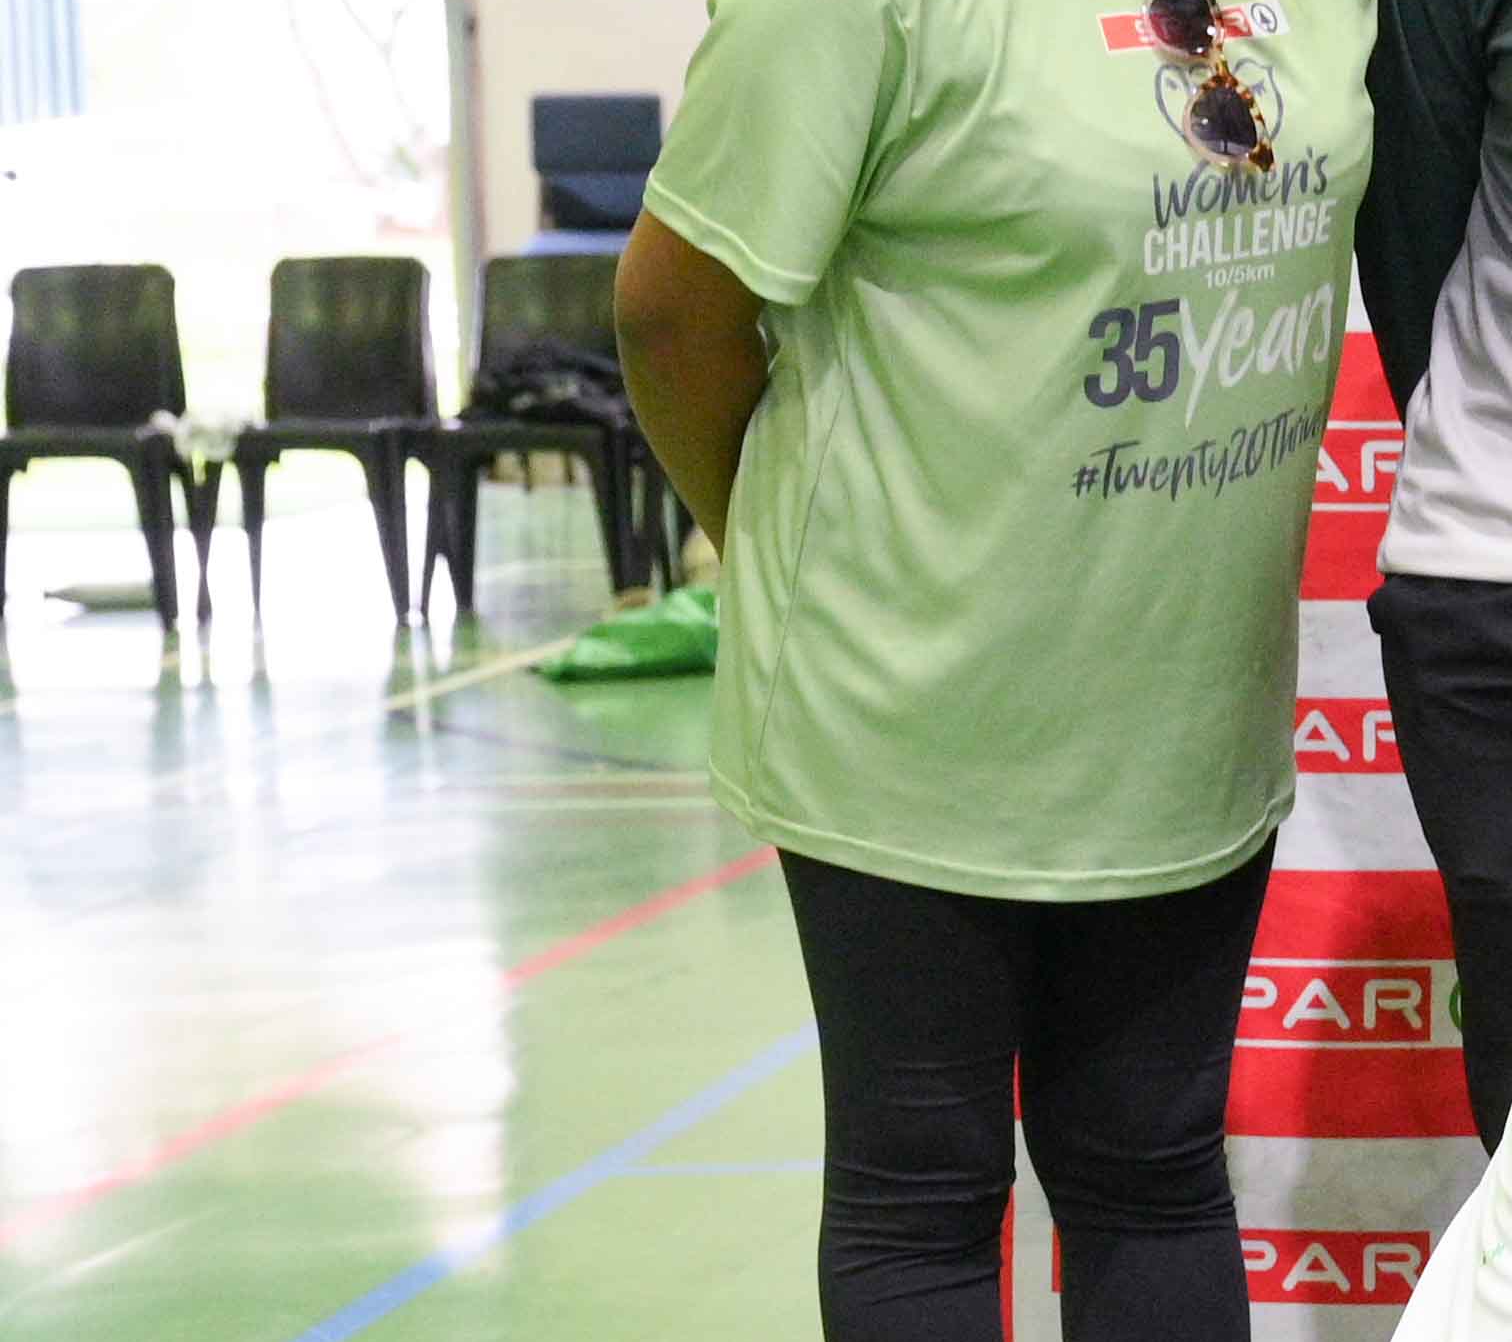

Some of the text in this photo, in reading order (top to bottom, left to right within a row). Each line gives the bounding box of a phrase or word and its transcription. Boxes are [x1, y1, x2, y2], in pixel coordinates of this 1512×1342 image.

[1154, 147, 1329, 229] Women's
[1143, 200, 1338, 277] CHALLENGE
[1205, 263, 1275, 289] 10/5km
[1084, 299, 1181, 409] 35
[1241, 976, 1423, 1030] PAR
